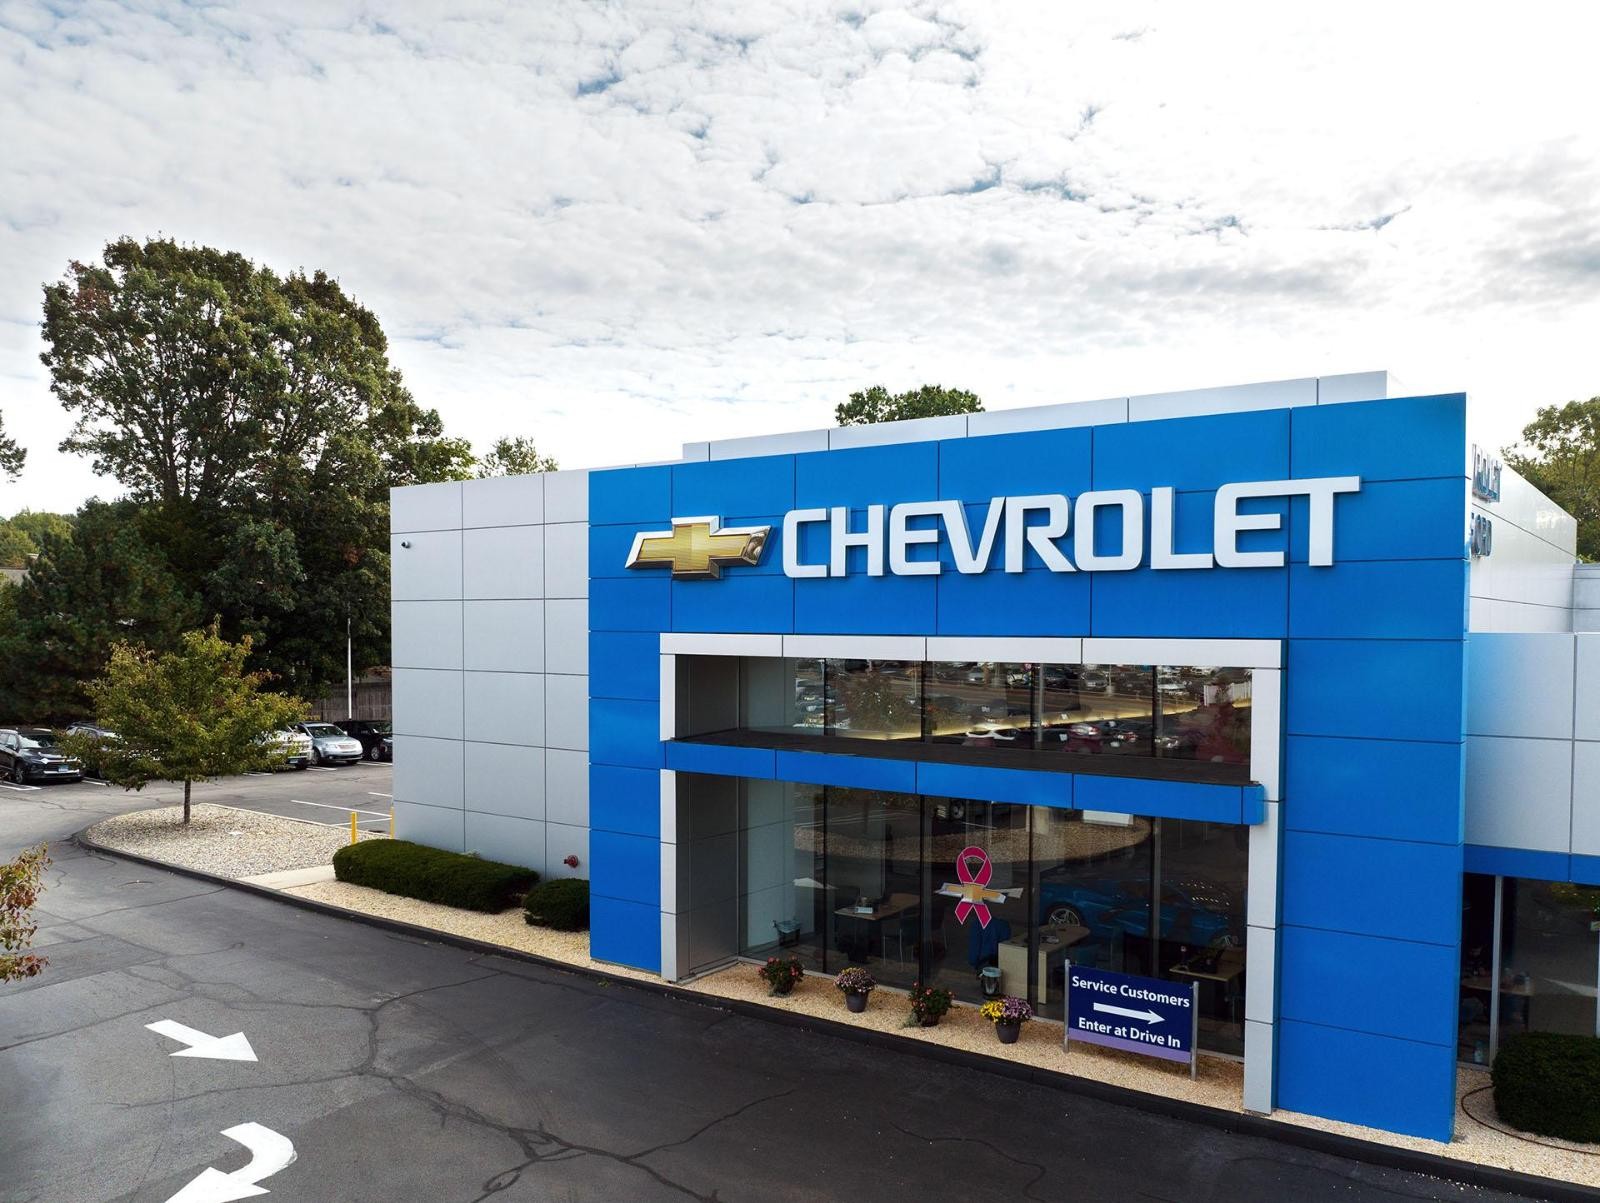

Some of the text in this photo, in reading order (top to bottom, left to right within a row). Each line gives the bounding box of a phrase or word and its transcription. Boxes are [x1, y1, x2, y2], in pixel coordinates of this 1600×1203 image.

[783, 476, 1361, 578] CHEVROLET
[1072, 976, 1190, 1008] Service Customers
[1078, 1017, 1181, 1048] Enter at Drive In
